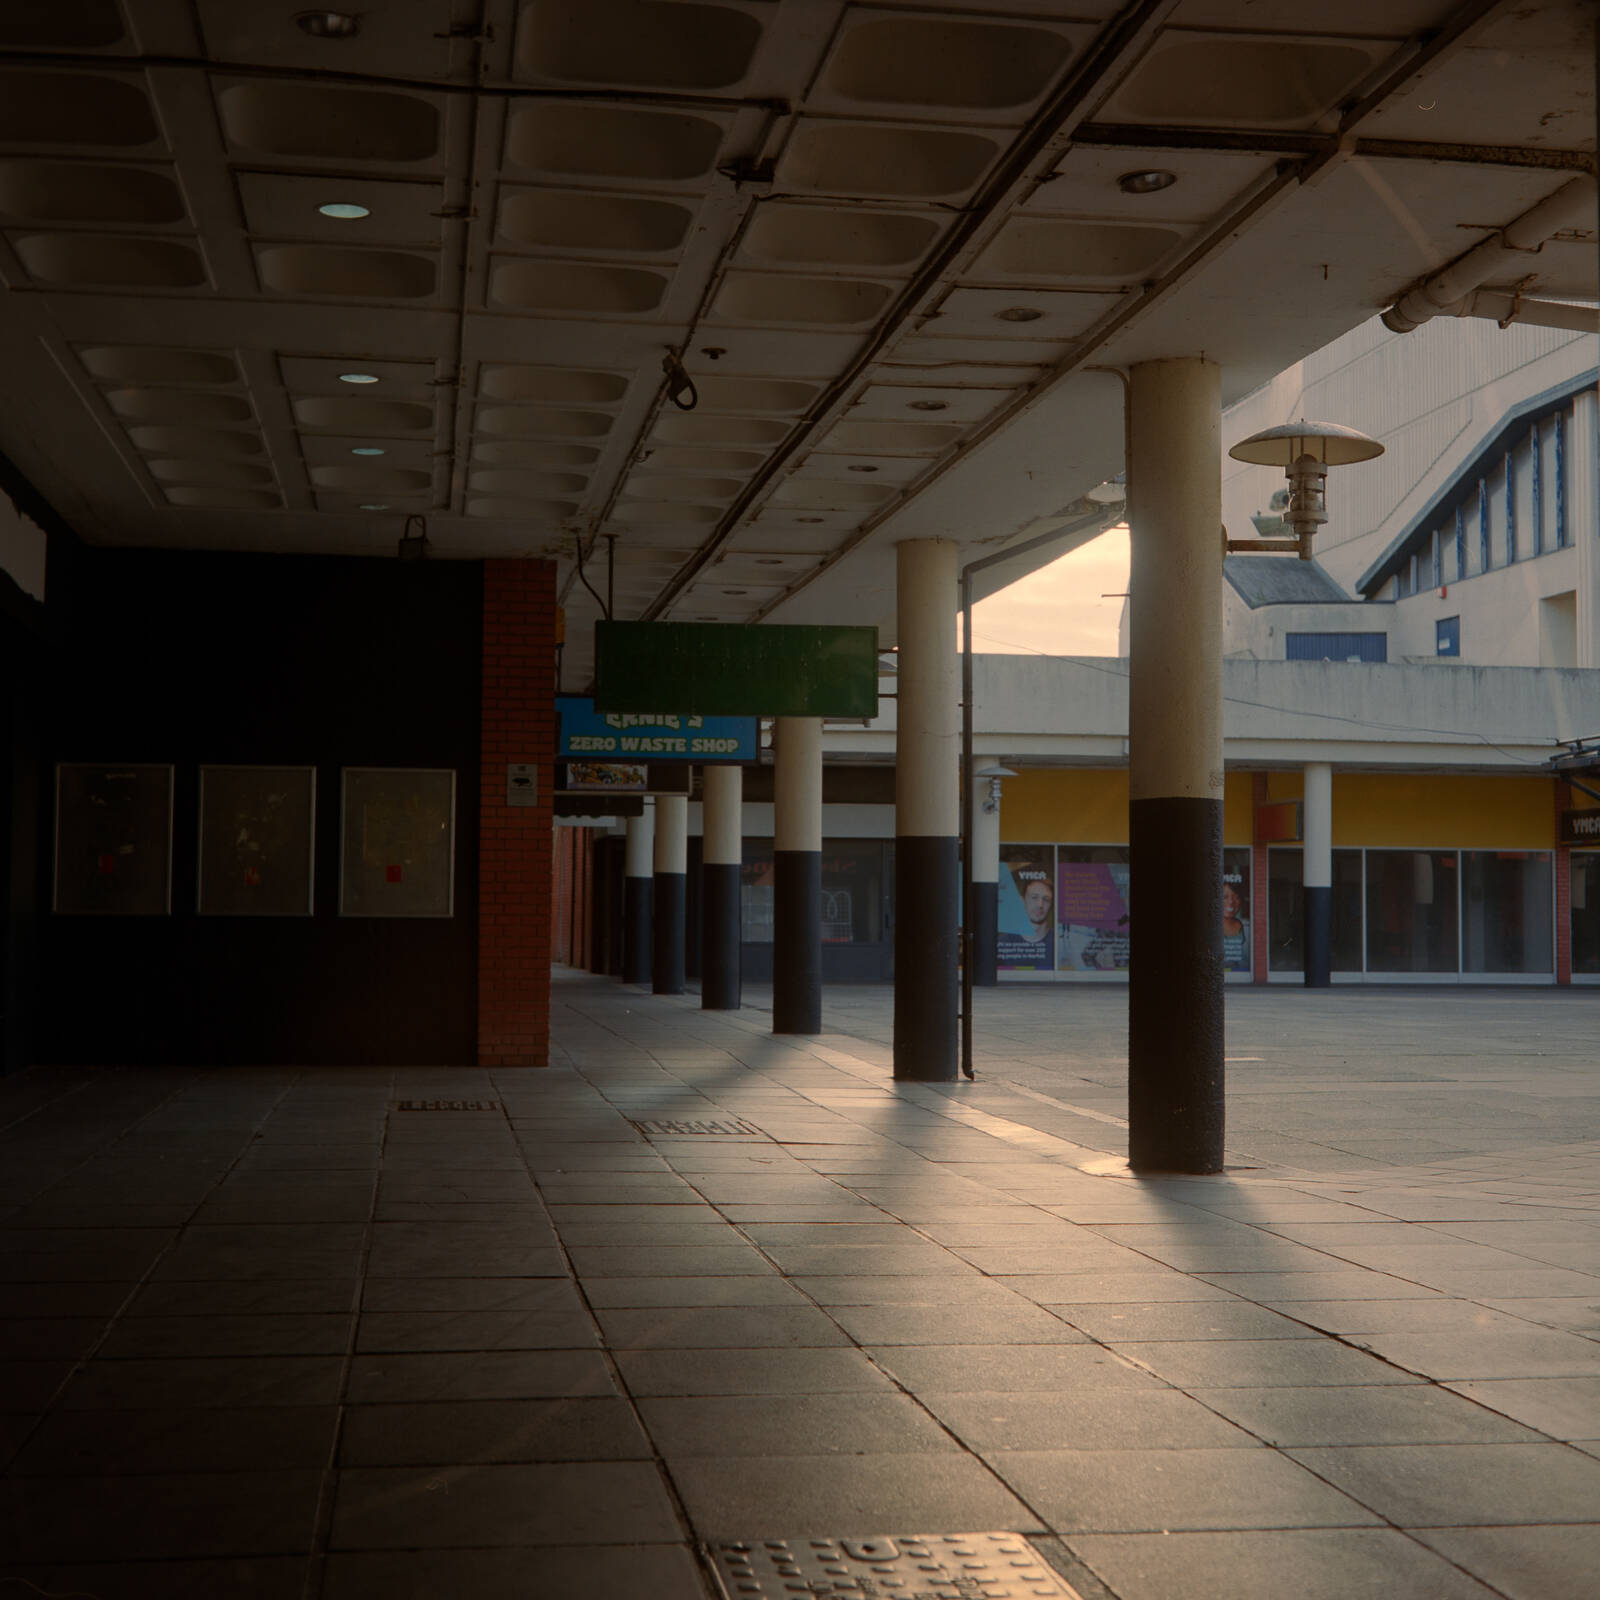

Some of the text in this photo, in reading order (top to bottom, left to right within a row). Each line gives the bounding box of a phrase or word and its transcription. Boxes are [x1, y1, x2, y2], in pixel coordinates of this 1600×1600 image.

[606, 714, 703, 729] ERNIES
[569, 737, 739, 753] ZERO WASTE SHOP
[1018, 871, 1047, 880] YMCA
[1223, 874, 1242, 883] MCA
